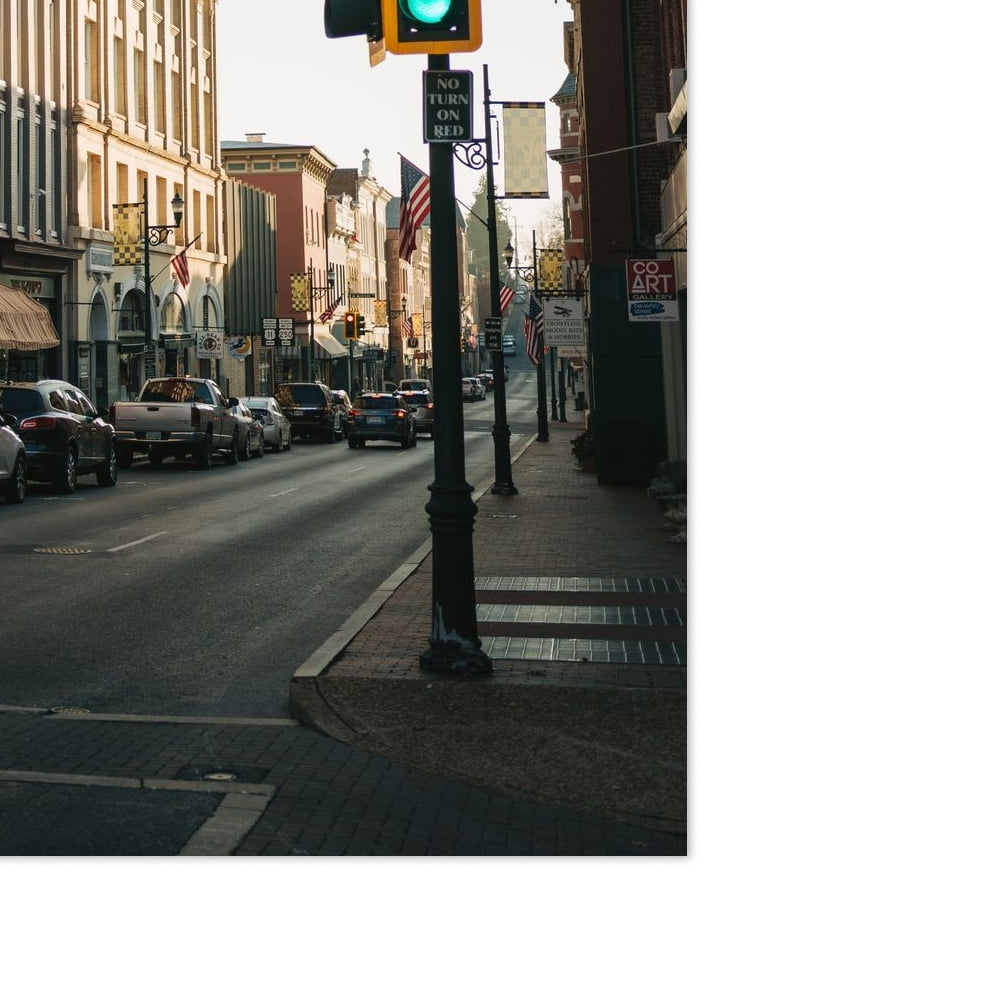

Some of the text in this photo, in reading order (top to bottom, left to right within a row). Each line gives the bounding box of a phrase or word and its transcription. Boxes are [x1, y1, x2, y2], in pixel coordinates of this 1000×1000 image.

[437, 78, 460, 89] NO
[428, 93, 468, 104] TURN
[437, 109, 460, 120] ON
[434, 125, 464, 136] RED
[633, 262, 659, 274] CO
[632, 274, 672, 293] ART
